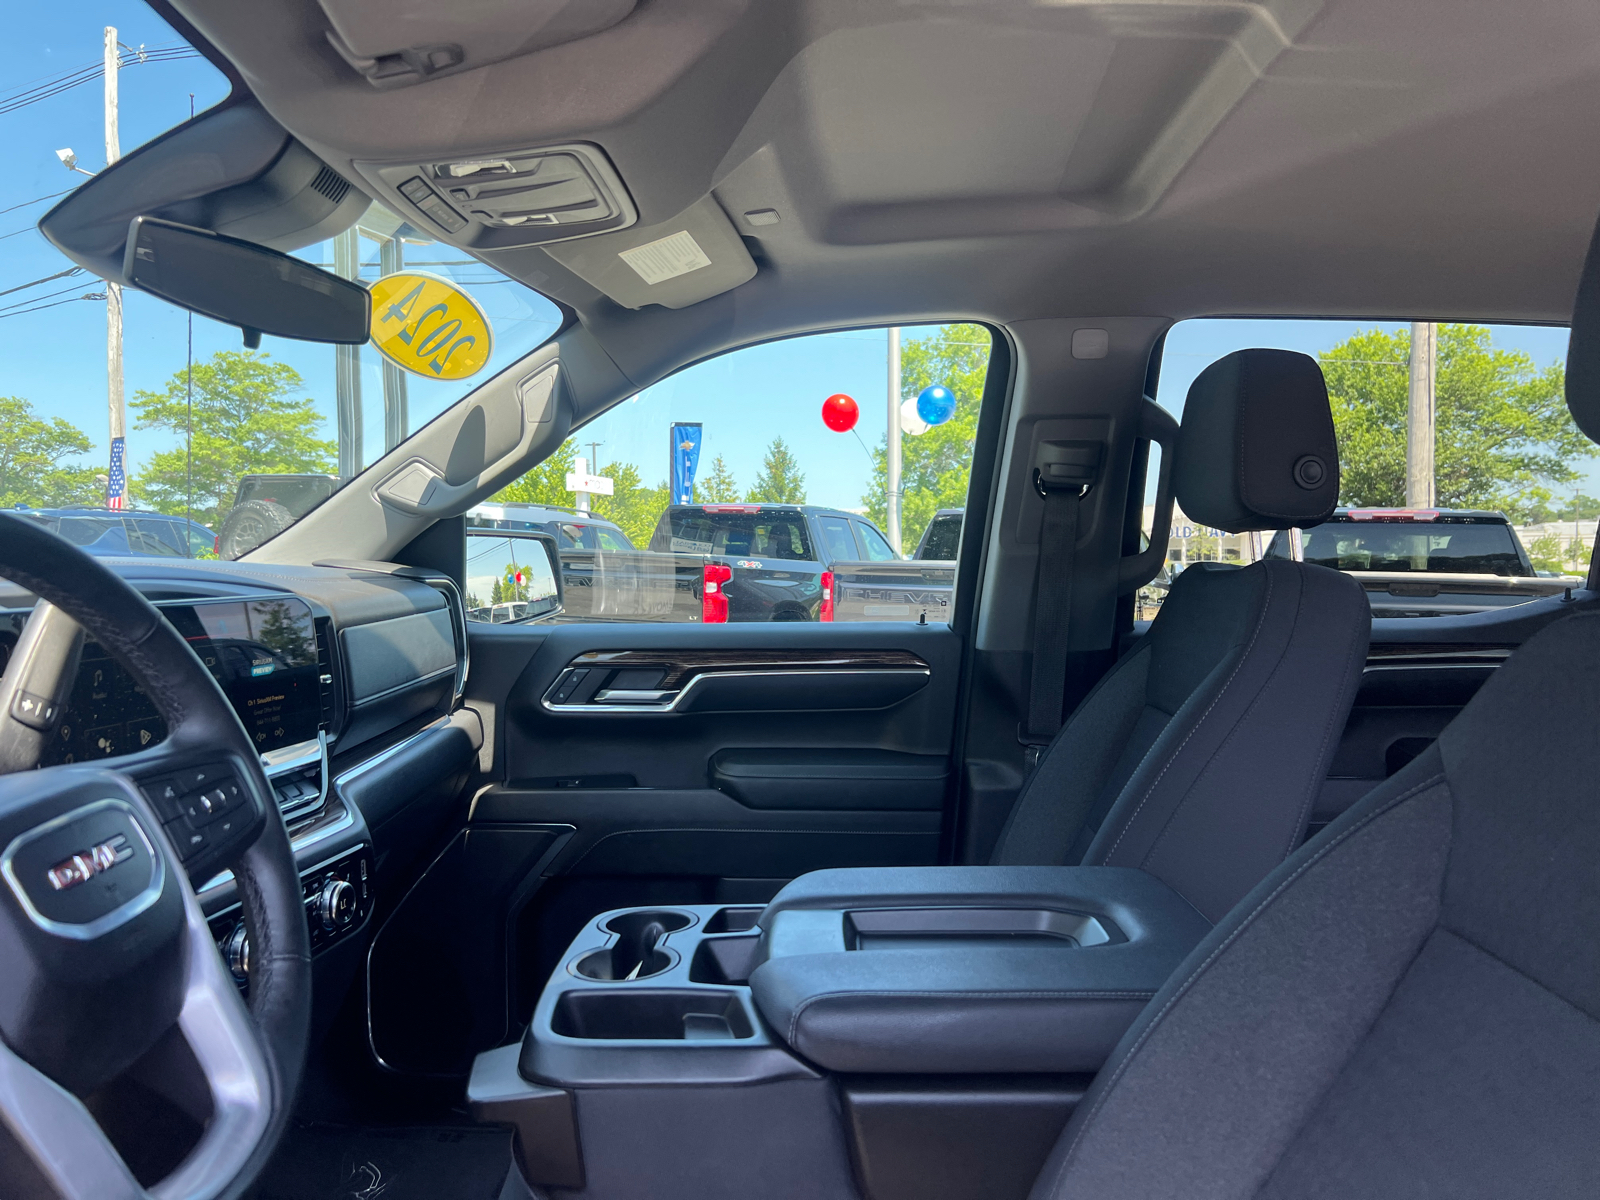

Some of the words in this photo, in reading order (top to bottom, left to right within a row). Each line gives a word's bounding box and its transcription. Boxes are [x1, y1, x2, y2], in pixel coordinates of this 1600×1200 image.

[846, 588, 949, 605] CHEVR
[253, 666, 273, 674] PREVIEW
[47, 832, 134, 891] GMC
